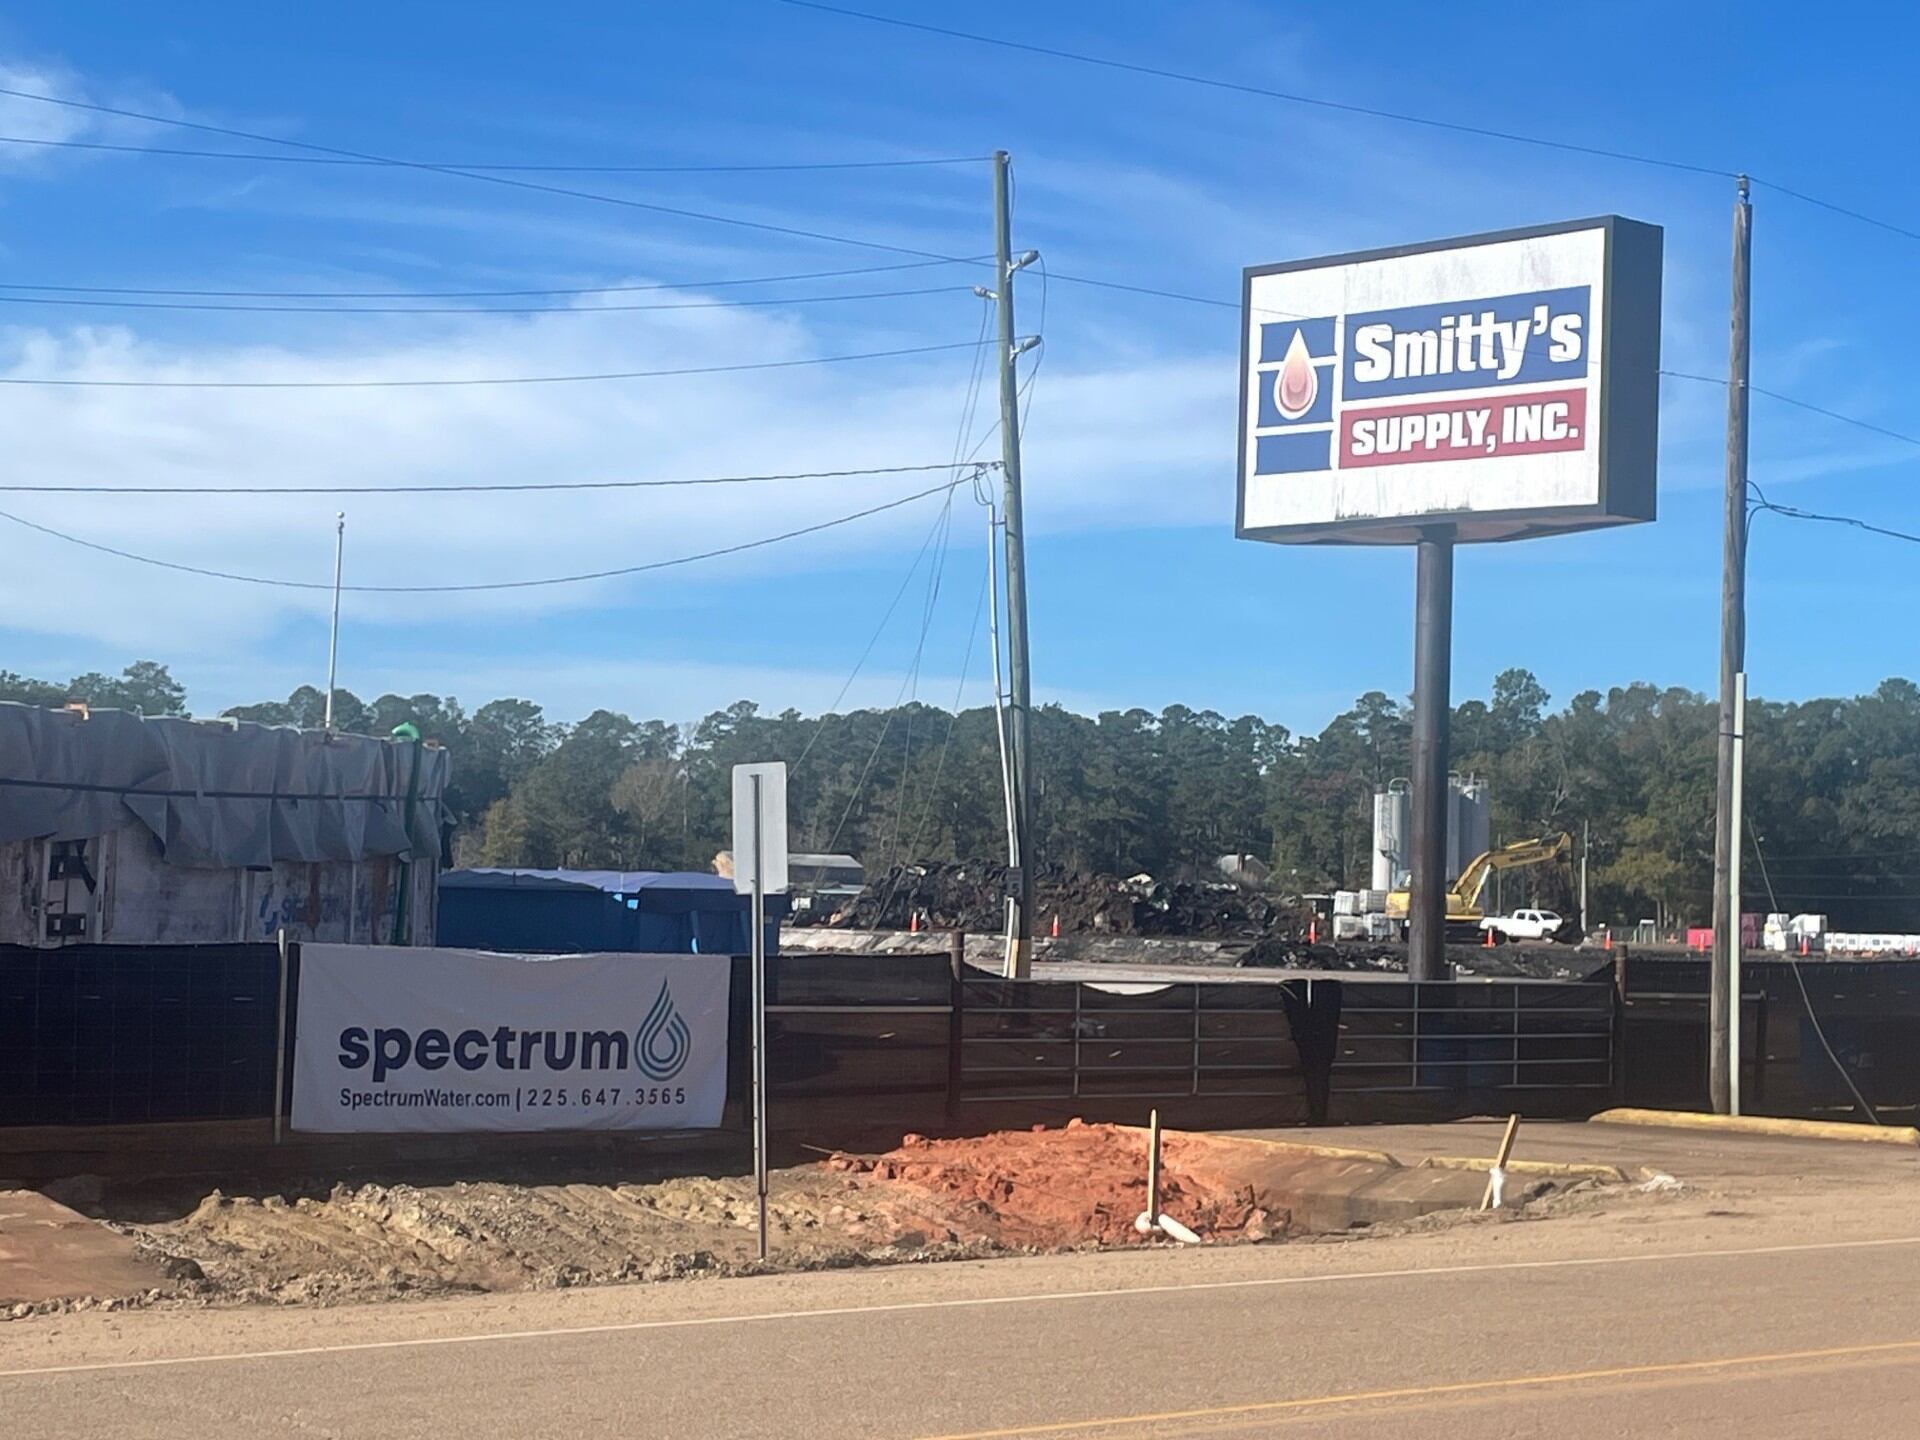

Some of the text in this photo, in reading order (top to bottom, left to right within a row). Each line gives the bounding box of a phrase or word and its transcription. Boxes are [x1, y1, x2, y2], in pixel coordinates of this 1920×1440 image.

[1354, 305, 1582, 383] Smitty's
[1351, 402, 1579, 454] SUPPLY, INC.
[338, 1026, 629, 1082] spectrum
[339, 1087, 510, 1111] SpectrumWater.com
